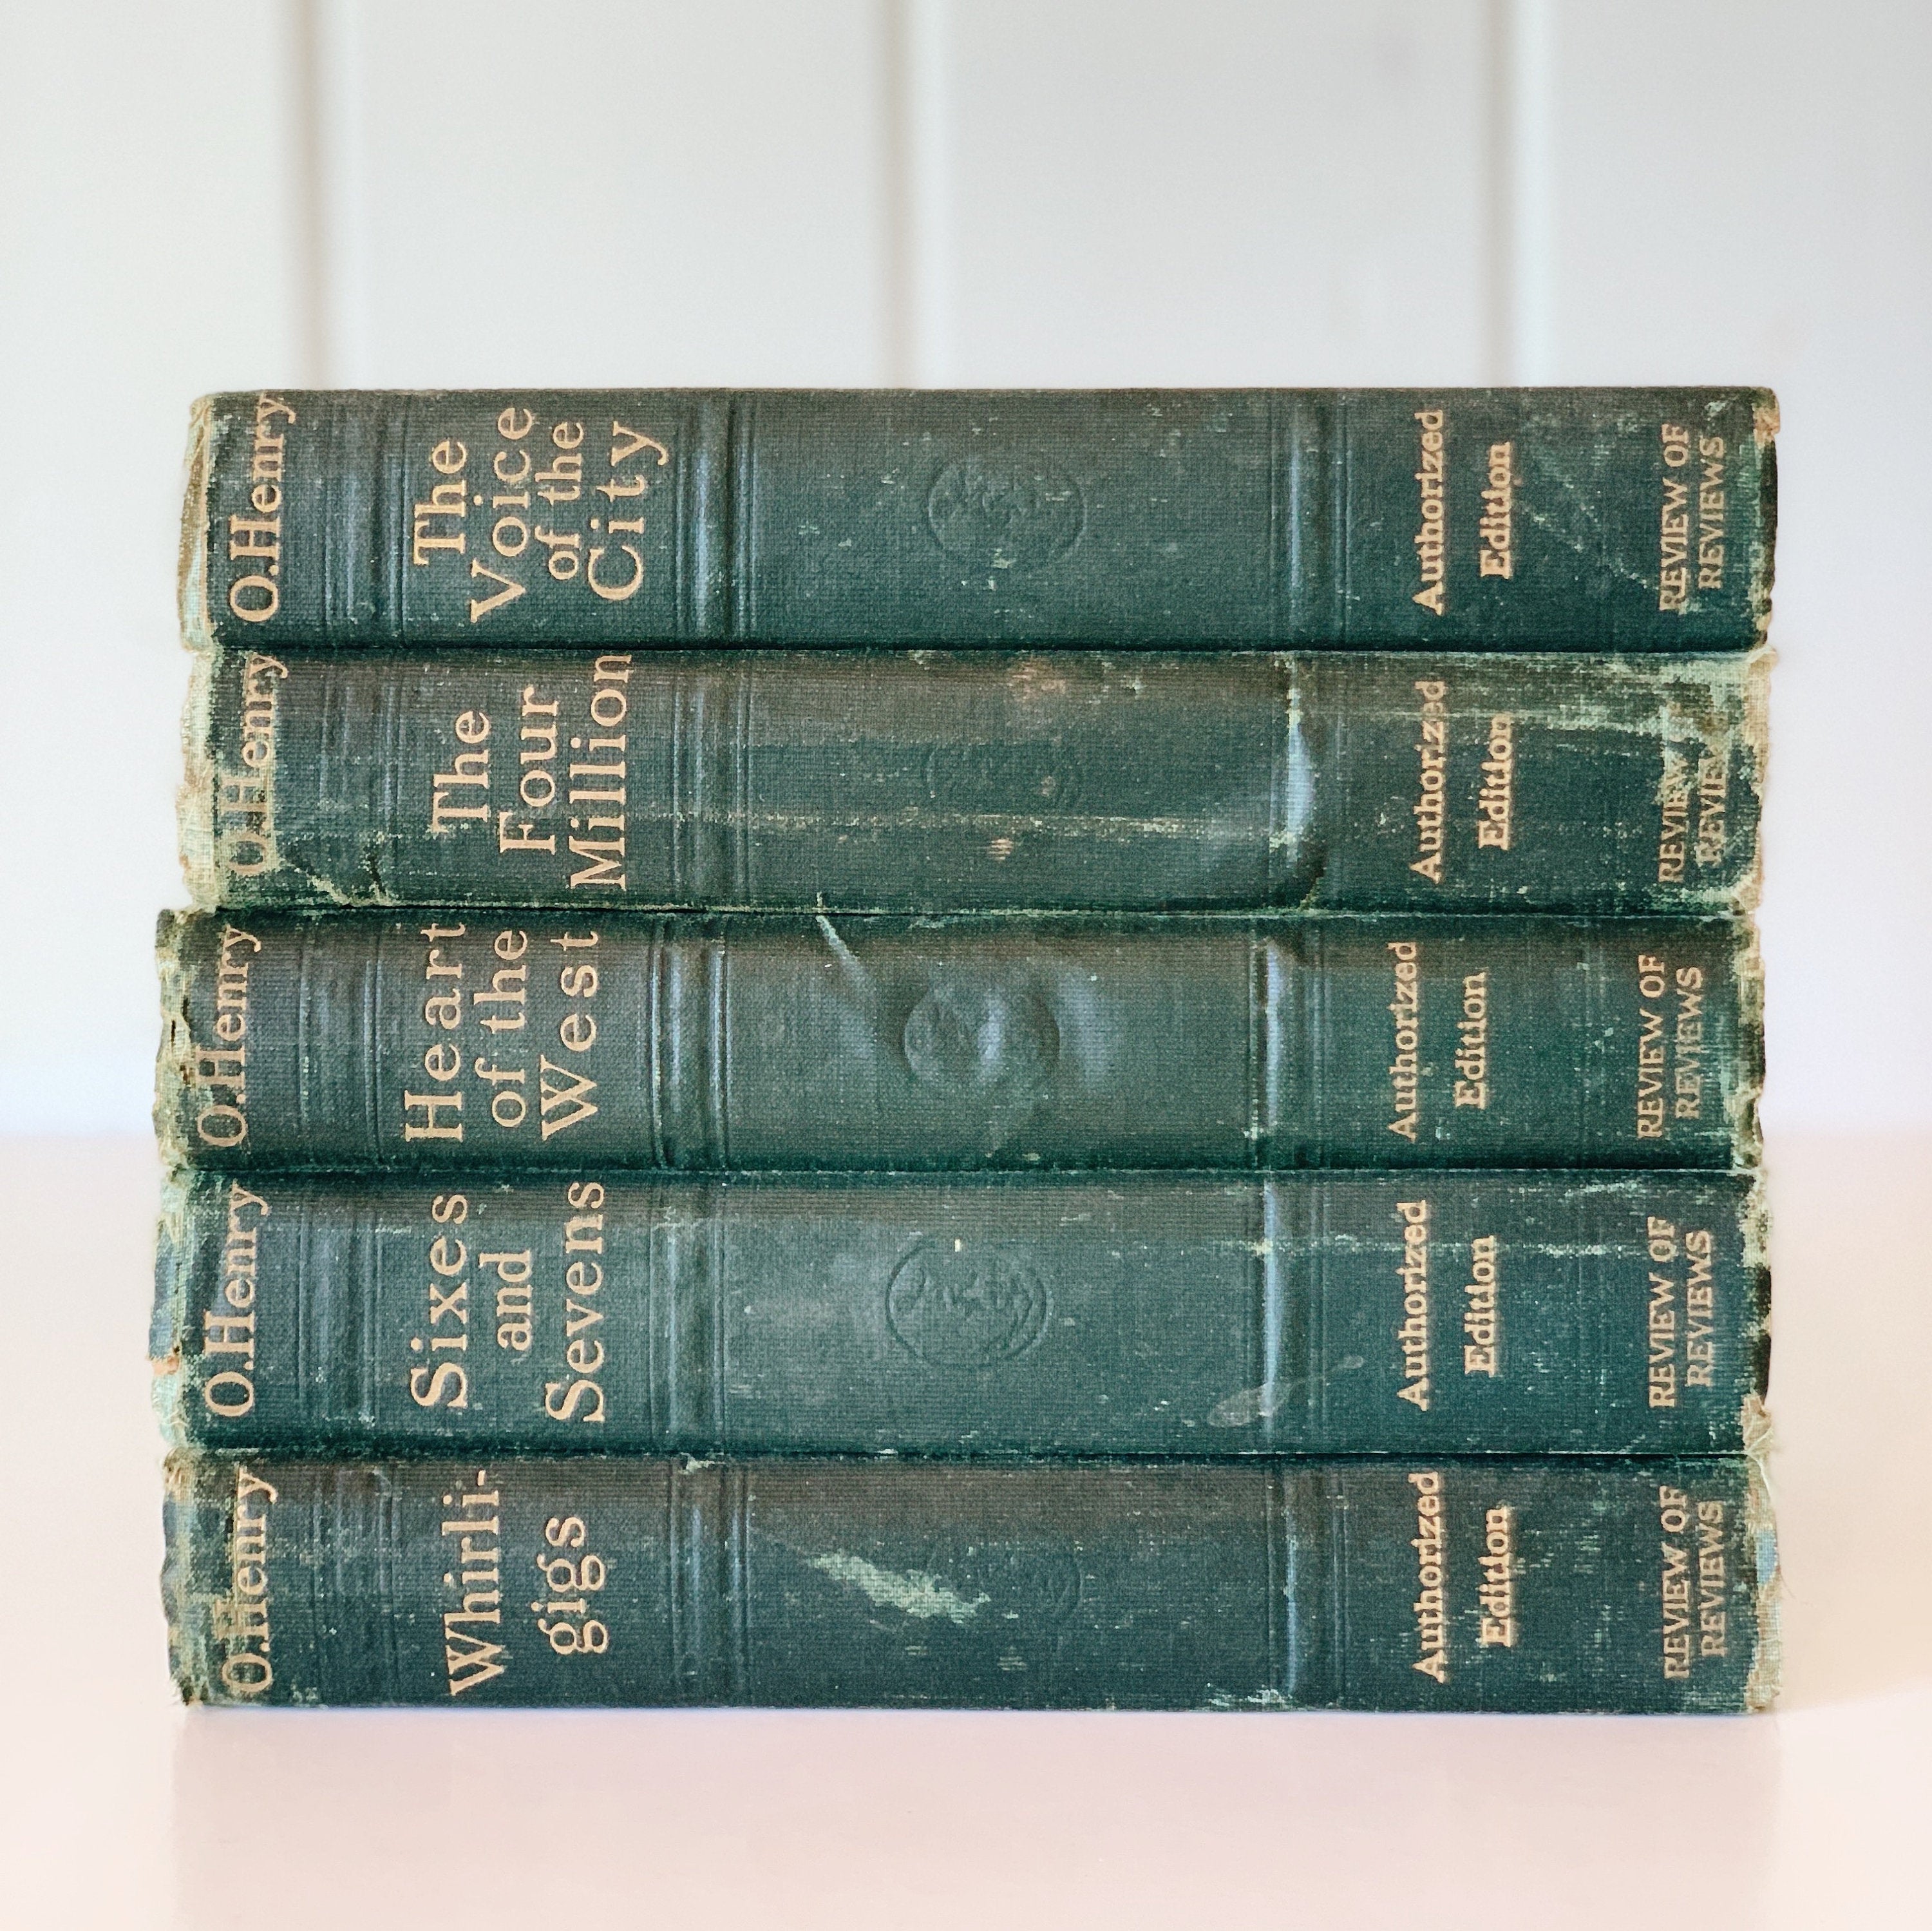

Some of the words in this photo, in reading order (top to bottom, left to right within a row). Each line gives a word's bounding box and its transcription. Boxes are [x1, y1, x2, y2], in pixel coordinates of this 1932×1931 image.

[230, 394, 295, 622] O.Henry
[414, 439, 468, 565] The
[471, 408, 533, 623] Voice
[536, 421, 583, 505] the
[589, 421, 668, 601] City
[1412, 410, 1443, 616] Authorized
[1481, 441, 1512, 579] Edition
[1662, 423, 1690, 468] OF
[1699, 437, 1724, 589] REVIEWS
[535, 520, 580, 580] of
[1660, 478, 1689, 611] REVIEW
[430, 710, 489, 833] The
[499, 686, 559, 855] Four
[569, 654, 632, 891] Million
[1410, 681, 1447, 884] Authorized
[1479, 712, 1513, 851] Edition
[1660, 752, 1689, 882] REVIEW
[1698, 741, 1727, 865] REVIE
[196, 925, 261, 1147] O.Henry
[404, 923, 466, 1141] Heart
[475, 930, 527, 1034] the
[540, 931, 599, 1141] West
[1387, 942, 1417, 1143] Authorized
[1454, 970, 1487, 1108] Edition
[1638, 954, 1665, 998] OF
[1675, 966, 1703, 1119] REVIEWS
[475, 1057, 526, 1127] of
[1638, 1009, 1663, 1139] REVIEW
[203, 1179, 270, 1416] O.Henry
[411, 1194, 469, 1409] Sixes
[479, 1250, 531, 1352] and
[545, 1182, 605, 1423] Sevens
[1397, 1199, 1428, 1411] Authorized
[1464, 1235, 1495, 1376] Edition
[1648, 1216, 1676, 1262] OF
[1687, 1230, 1712, 1387] REVIEWS
[1648, 1273, 1675, 1408] REVIEW
[215, 1463, 278, 1692] O.Henry
[1409, 1471, 1444, 1683] Authorized
[1478, 1507, 1511, 1647] Edition
[1660, 1485, 1687, 1532] OF
[1699, 1501, 1725, 1657] REVIEWS
[442, 1470, 504, 1697] Whirli-
[532, 1516, 609, 1654] gigs
[1662, 1543, 1690, 1679] REVIEW
